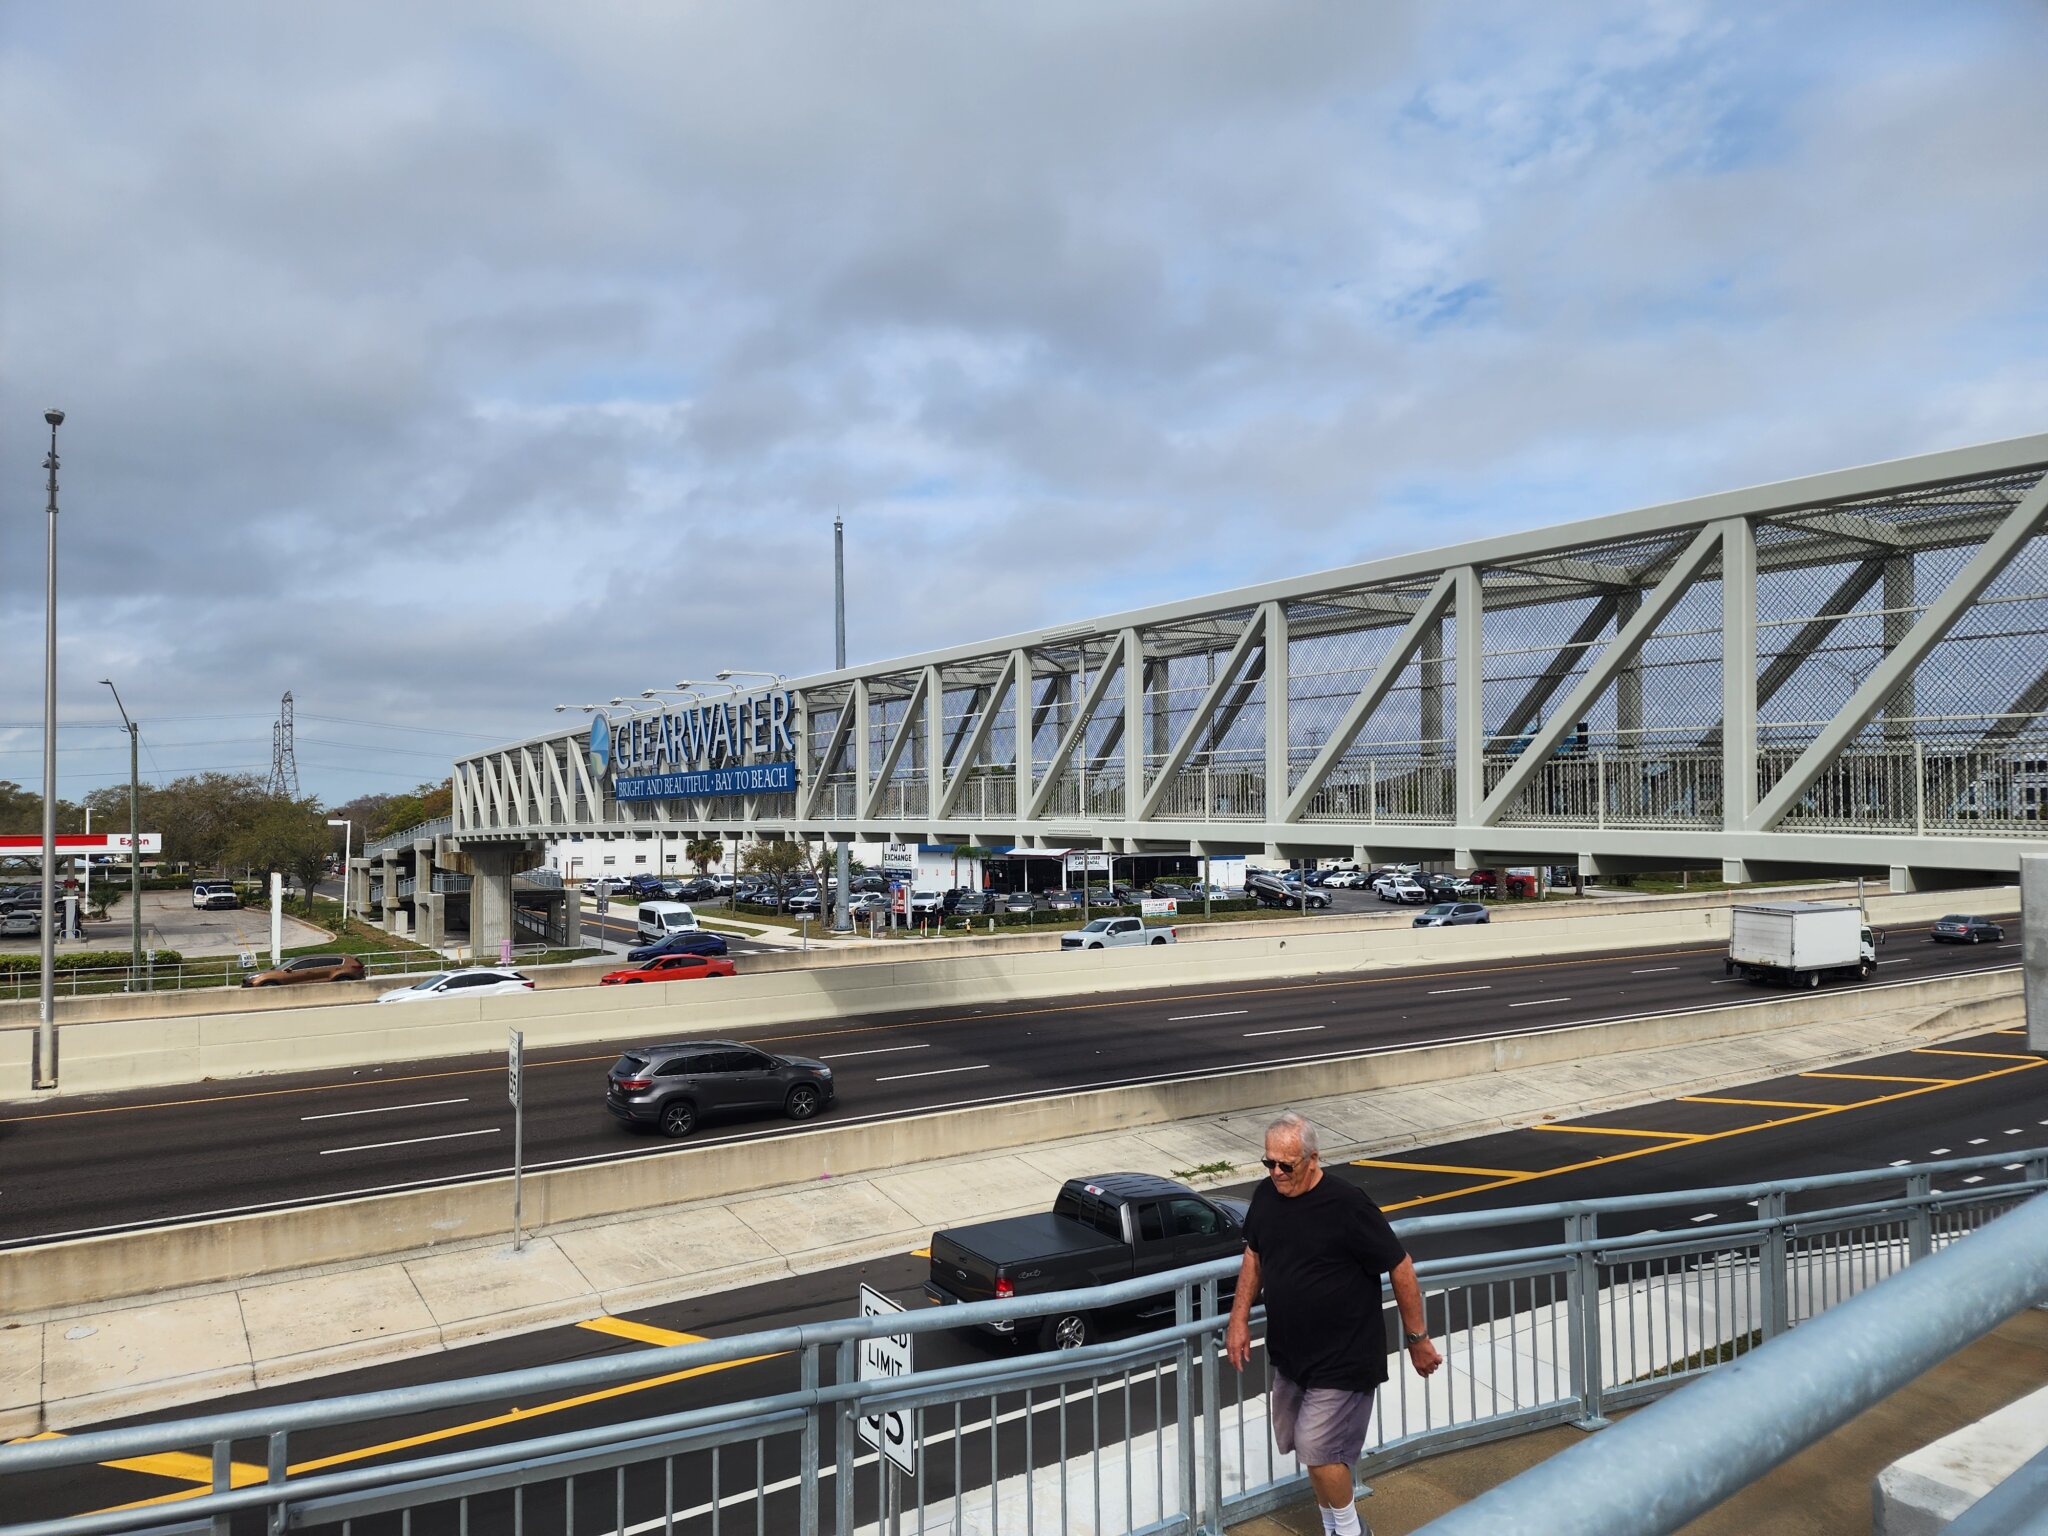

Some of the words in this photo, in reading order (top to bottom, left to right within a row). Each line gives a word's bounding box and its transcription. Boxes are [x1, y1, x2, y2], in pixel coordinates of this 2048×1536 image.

[615, 690, 795, 770] CLEARWATER
[618, 780, 645, 798] BRIGHT
[646, 778, 663, 796] AND
[664, 774, 711, 795] BEAUTIFUL
[715, 772, 734, 791] BAY
[734, 770, 749, 790] TO
[751, 767, 788, 789] BEACH
[120, 837, 150, 847] Exon
[890, 843, 907, 852] AUTO
[884, 853, 912, 862] EXCHANGE
[868, 1342, 903, 1377] LIMIT
